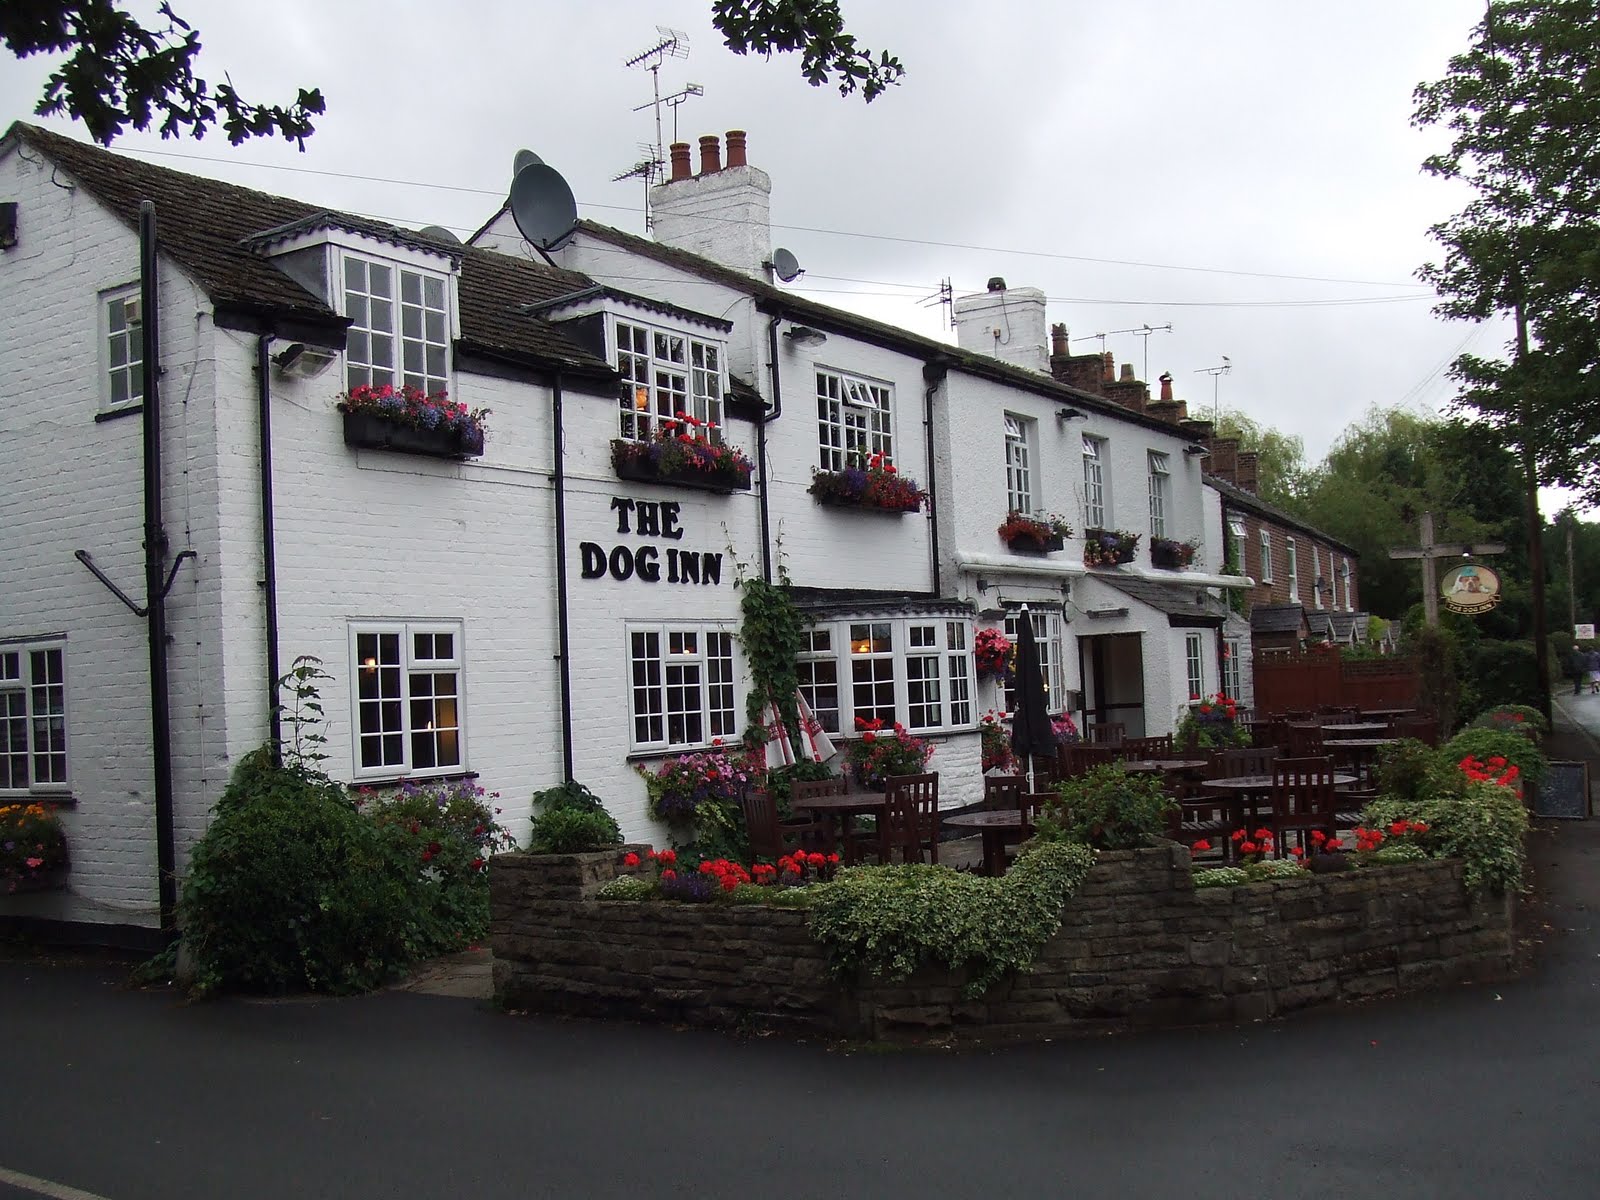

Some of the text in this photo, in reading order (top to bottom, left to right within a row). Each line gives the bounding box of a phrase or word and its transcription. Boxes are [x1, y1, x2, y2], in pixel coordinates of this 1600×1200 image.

[610, 496, 684, 540] THE
[579, 541, 723, 586] DOG INN
